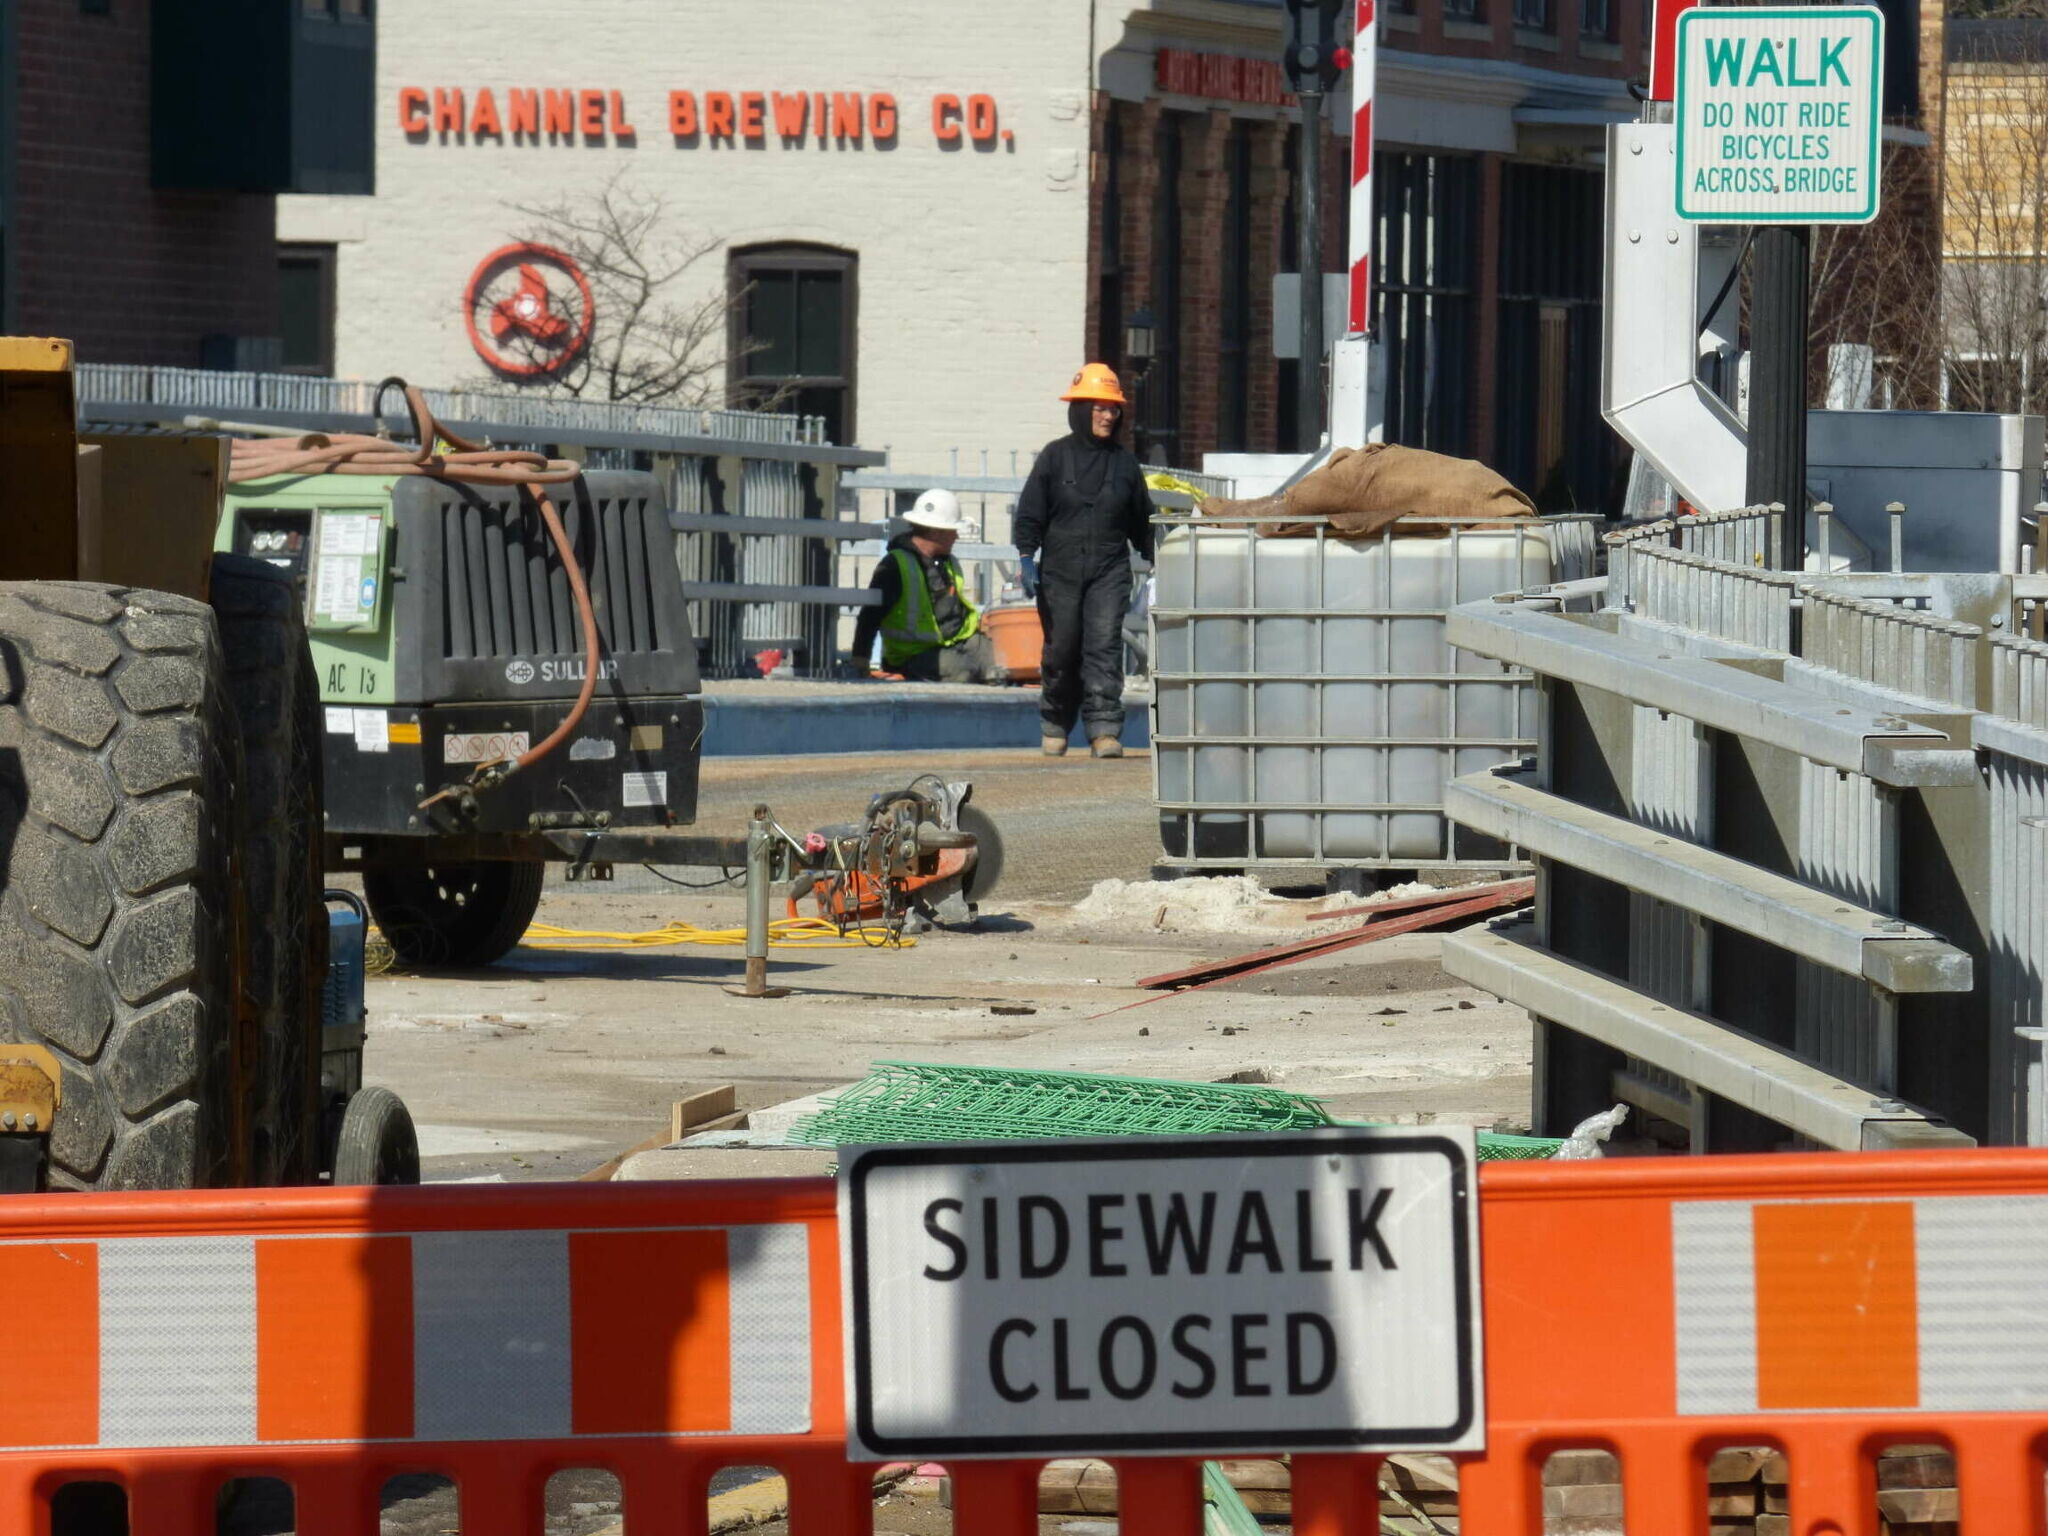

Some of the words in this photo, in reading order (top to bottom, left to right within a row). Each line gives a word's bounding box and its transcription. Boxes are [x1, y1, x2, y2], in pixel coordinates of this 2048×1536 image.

[1704, 36, 1853, 88] WALK
[398, 86, 635, 135] CHANNEL
[668, 89, 898, 138] BREWING
[931, 92, 1014, 141] CO.
[1703, 102, 1733, 127] DO
[1745, 102, 1788, 127] NOT
[1798, 102, 1851, 127] RIDE
[1721, 134, 1830, 160] BICYCLES
[1694, 167, 1774, 193] ACROSS
[1784, 167, 1857, 192] BRIDGE
[327, 663, 346, 693] AC
[540, 659, 618, 682] SULLIR
[923, 1186, 1398, 1282] SIDEWALK
[987, 1312, 1339, 1404] CLOSED
